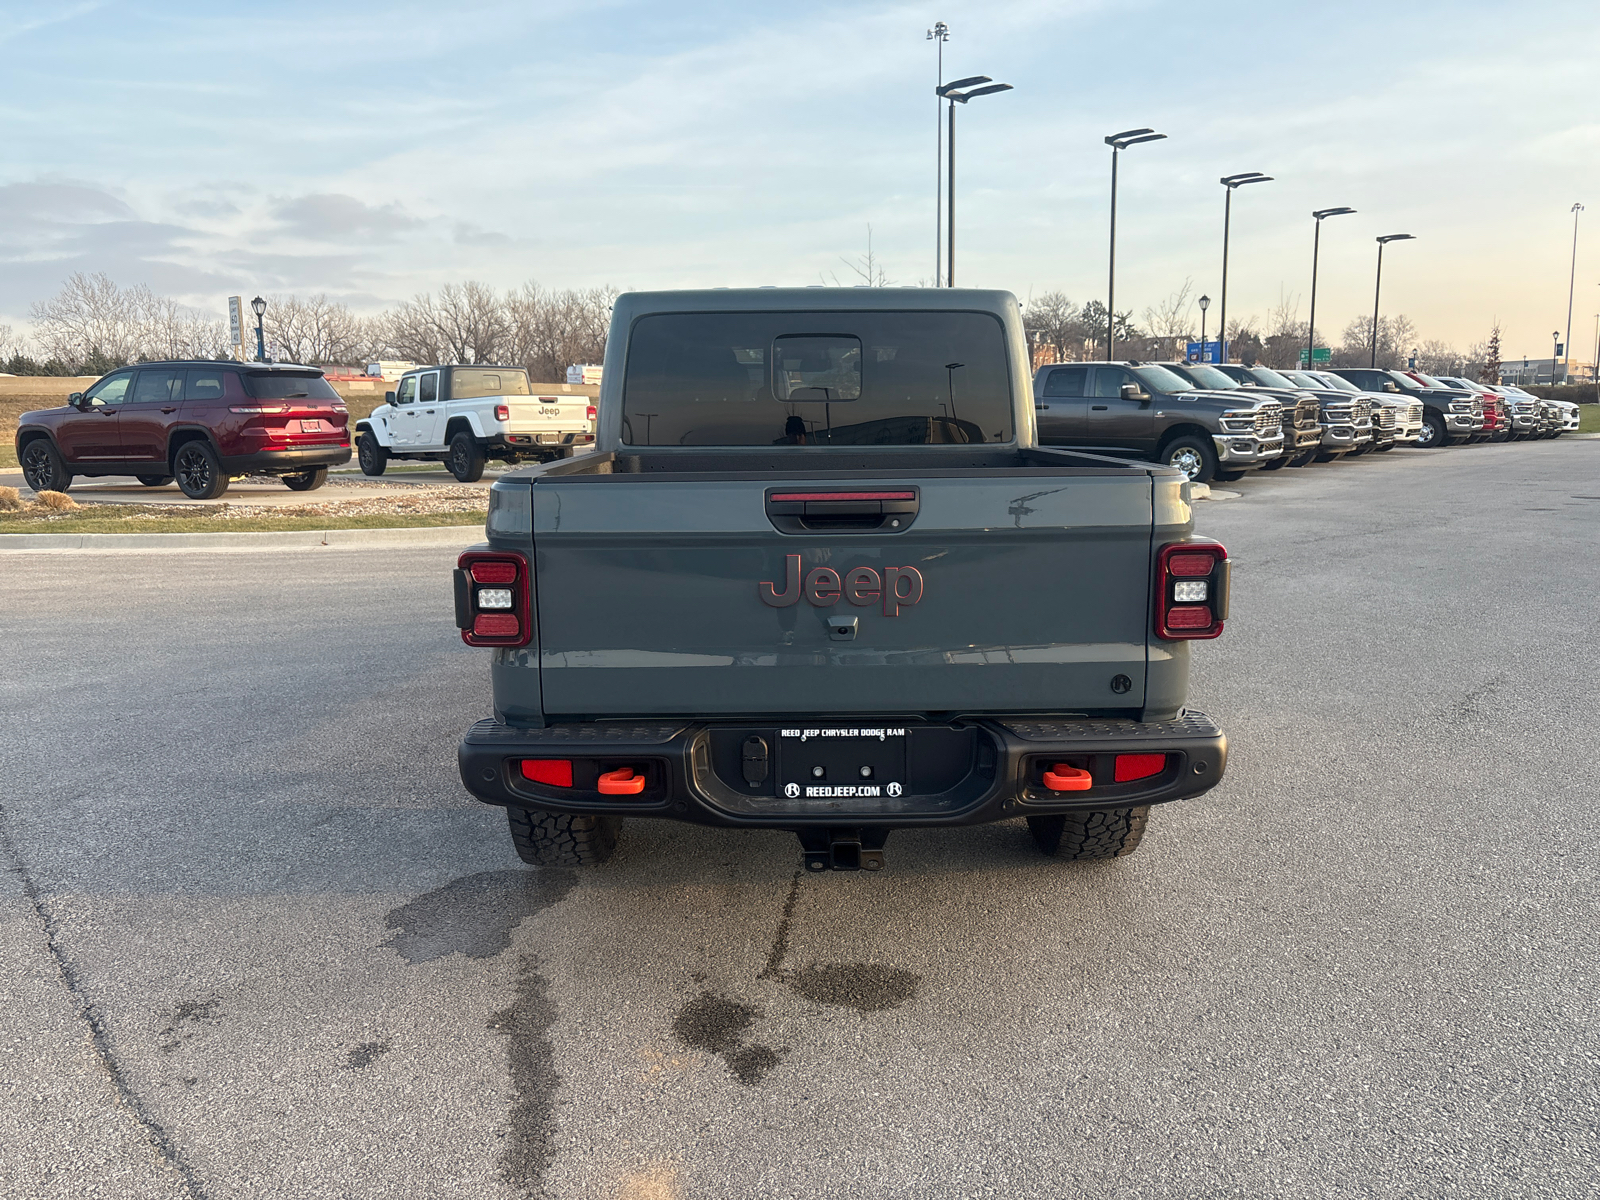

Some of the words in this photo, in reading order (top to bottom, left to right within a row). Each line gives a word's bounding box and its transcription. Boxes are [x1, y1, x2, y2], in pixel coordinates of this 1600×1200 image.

[538, 406, 560, 416] Jeep
[759, 554, 924, 617] Jeep
[781, 729, 800, 737] REED
[803, 729, 819, 737] JEEP
[821, 728, 859, 737] CHRYSLER
[860, 728, 885, 737] DODGE
[886, 728, 905, 736] RAM
[806, 786, 880, 797] REEDJEEP.COM
